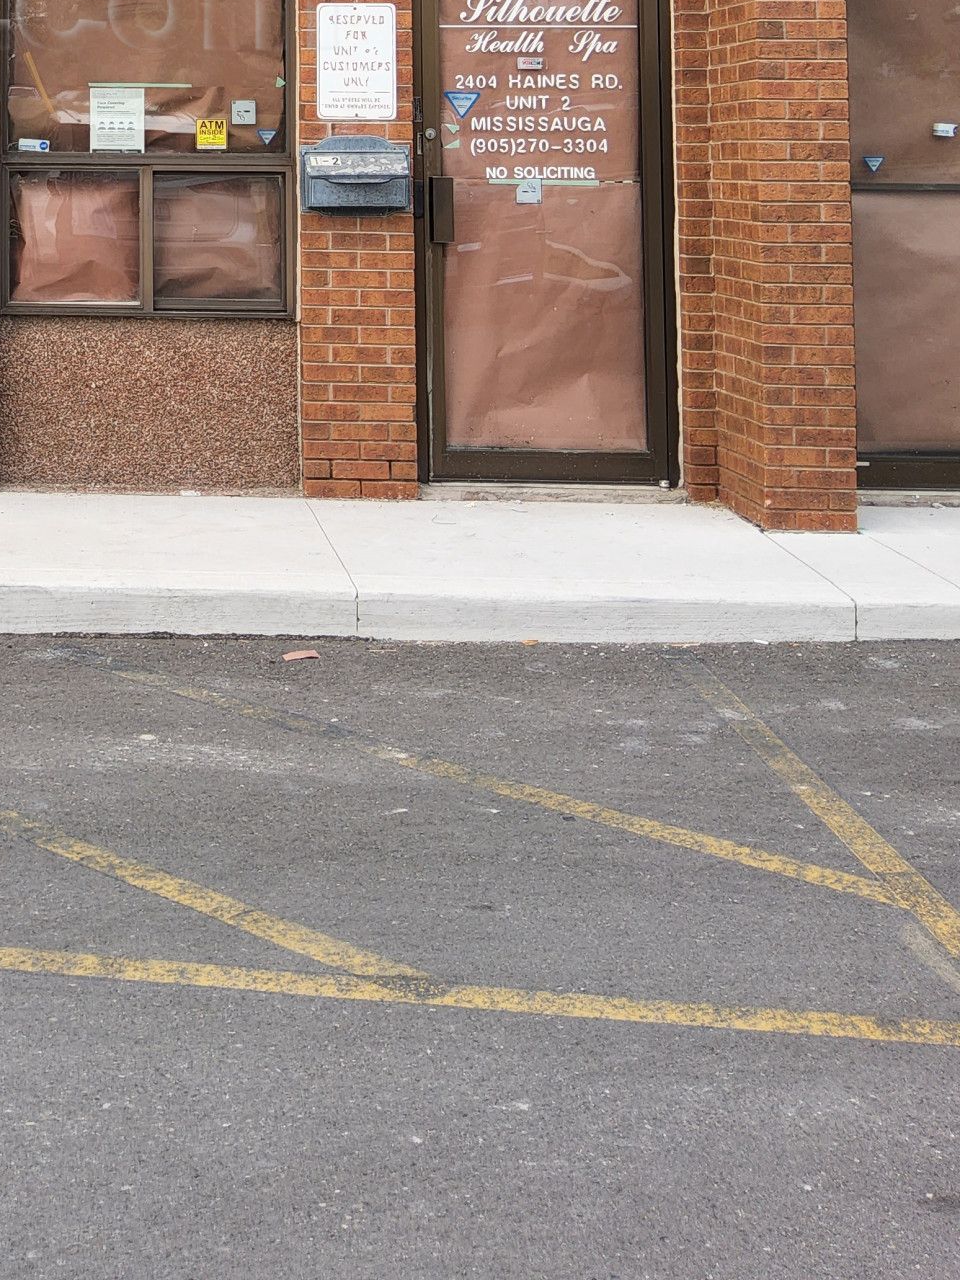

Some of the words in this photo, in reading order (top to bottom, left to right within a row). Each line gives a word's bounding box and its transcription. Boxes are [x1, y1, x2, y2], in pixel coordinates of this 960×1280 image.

[345, 30, 367, 40] FOR
[465, 30, 545, 54] Health
[568, 30, 618, 62] Spa
[454, 74, 497, 89] 2404
[508, 73, 580, 89] HAINES
[591, 73, 623, 90] RD.
[505, 95, 550, 110] UNIT
[560, 95, 571, 111] 2
[199, 120, 224, 130] ATM
[470, 116, 607, 132] MISSISSAUGA
[470, 138, 608, 157] (905)270-3304
[486, 167, 508, 179] NO
[514, 166, 596, 179] SOLICITING
